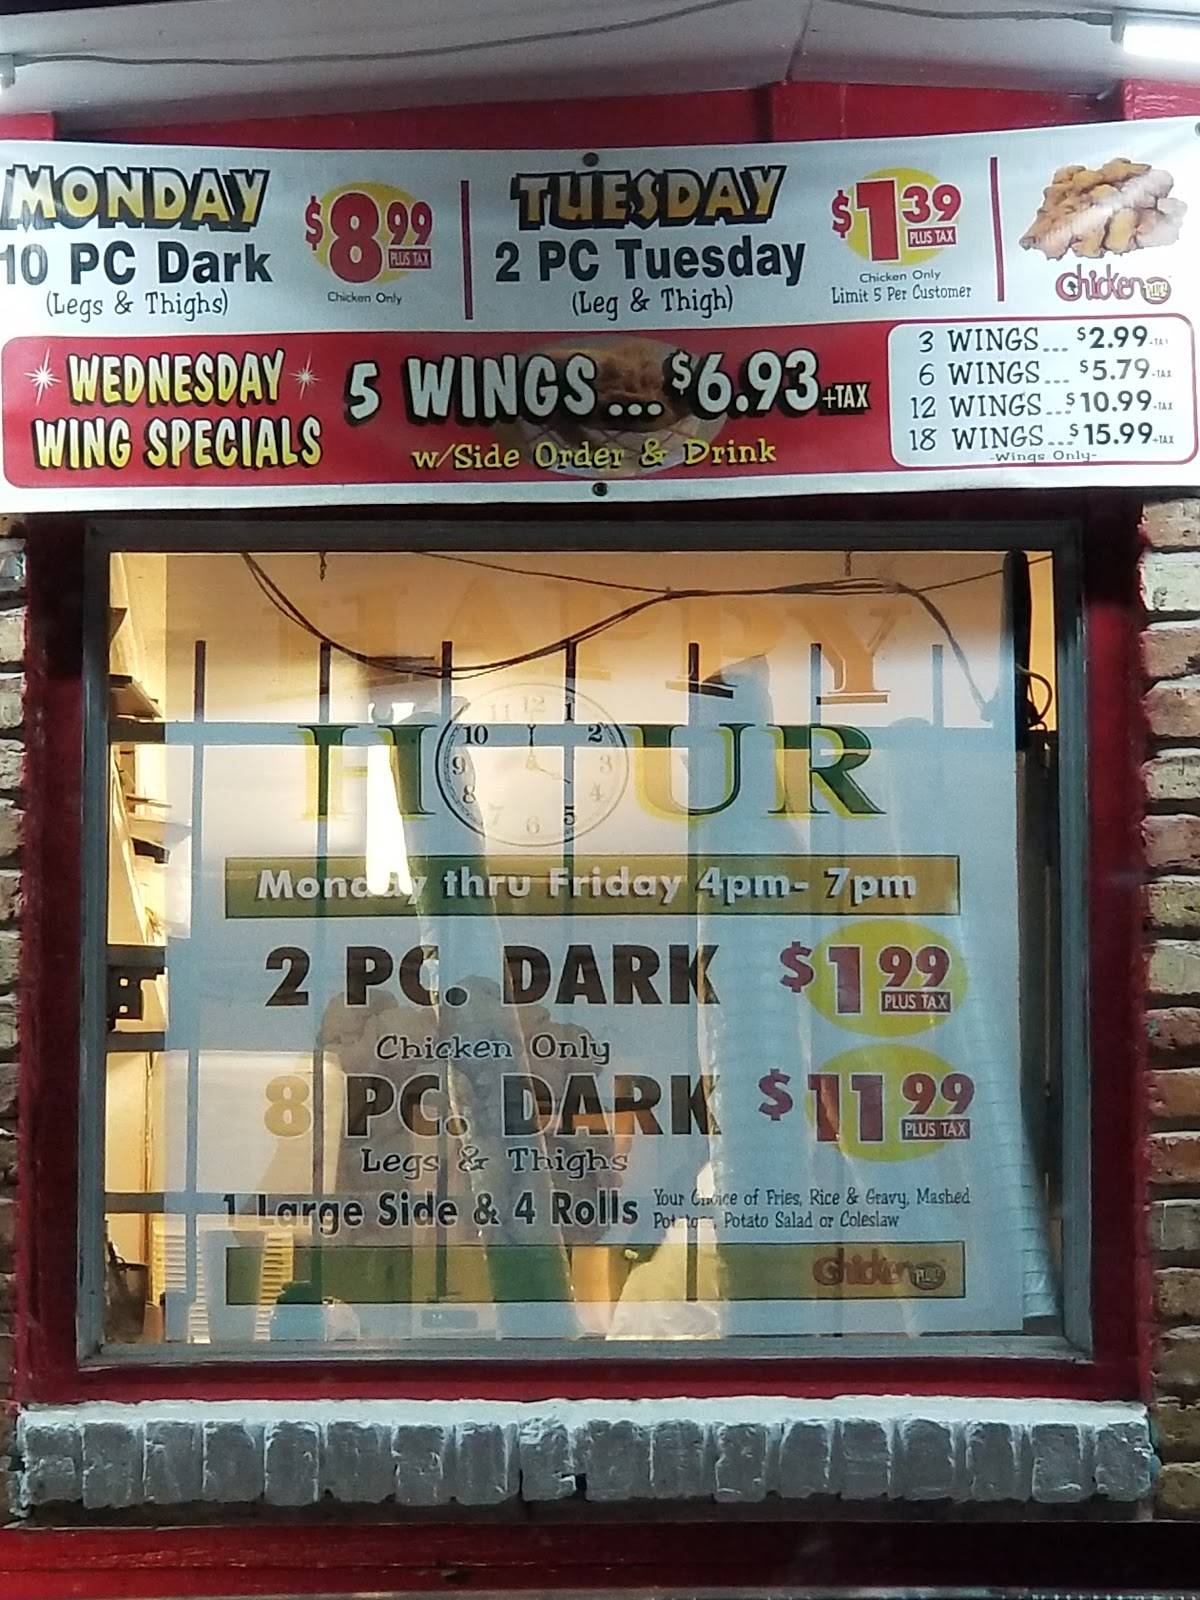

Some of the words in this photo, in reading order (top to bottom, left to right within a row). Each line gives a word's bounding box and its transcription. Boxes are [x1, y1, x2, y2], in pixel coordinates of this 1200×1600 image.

[0, 164, 270, 232] MONDAY
[511, 166, 787, 230] TUESDAY
[909, 231, 933, 245] PLUS
[935, 229, 955, 243] TAX
[0, 244, 48, 285] 10
[70, 241, 136, 285] PC
[158, 241, 273, 285] Dark
[390, 251, 410, 266] PLUS
[413, 251, 430, 267] TAX
[495, 241, 520, 281] 2
[539, 239, 599, 281] PC
[615, 235, 806, 286] Tuesday
[859, 270, 907, 283] Chicken
[912, 269, 942, 281] Only
[46, 290, 104, 321] (Legs
[114, 290, 134, 313] &
[145, 289, 228, 318] Thighs)
[327, 291, 371, 303] Chicken
[375, 292, 402, 306] Only
[572, 291, 618, 321] (Leg
[630, 287, 650, 311] &
[661, 285, 734, 319] Thigh)
[831, 285, 868, 305] Limit
[887, 287, 908, 301] Per
[912, 282, 972, 300] Customer
[919, 331, 934, 352] 3
[1077, 325, 1148, 349] $2.99
[66, 349, 286, 405] WEDNESDAY
[346, 361, 379, 424] 5
[664, 348, 819, 418] $6.93
[820, 382, 871, 413] +TAX
[918, 363, 935, 386] 6
[1080, 358, 1150, 381] $5.79
[911, 395, 936, 419] 12
[1066, 389, 1152, 413] $10.99
[33, 416, 132, 470] WING
[146, 415, 322, 469] SPECIALS
[909, 428, 938, 451] 18
[1069, 422, 1153, 445] $15.99
[534, 441, 626, 470] Order
[639, 438, 665, 467] &
[684, 437, 778, 466] Drink
[463, 725, 488, 745] 10
[587, 724, 602, 743] 2
[452, 756, 465, 775] 9
[462, 784, 476, 804] 8
[563, 806, 575, 826] 5
[255, 868, 427, 906] Monay
[443, 866, 531, 900] thru
[548, 866, 684, 905] Friday
[823, 866, 917, 906] 7pm
[265, 946, 311, 1007] 2
[346, 945, 468, 1006] PC.
[503, 944, 721, 1006] DARK
[884, 995, 916, 1011] PLUS
[921, 995, 948, 1010] TAX
[376, 1035, 513, 1060] Chicken
[531, 1034, 610, 1065] Only
[264, 1076, 311, 1136] 8
[346, 1075, 469, 1136] PC.
[503, 1074, 721, 1136] DARK
[904, 1124, 936, 1138] PLUS
[940, 1123, 967, 1137] TAX
[361, 1148, 440, 1180] Legs
[458, 1147, 488, 1172] &
[510, 1148, 628, 1178] Thighs
[654, 1188, 684, 1206] Your
[744, 1188, 760, 1206] of
[810, 1189, 840, 1205] Rice
[847, 1187, 859, 1204] &
[917, 1187, 970, 1205] Mashed
[224, 1193, 236, 1226] 1
[258, 1193, 363, 1236] Large
[377, 1191, 457, 1226] Side
[475, 1191, 499, 1225] &
[514, 1192, 535, 1225] 4
[552, 1191, 638, 1226] Rolls
[653, 1212, 717, 1229] Potto,
[725, 1212, 769, 1228] Potato
[775, 1211, 812, 1228] Salad
[820, 1216, 834, 1227] or
[840, 1210, 900, 1228] Coleslaw
